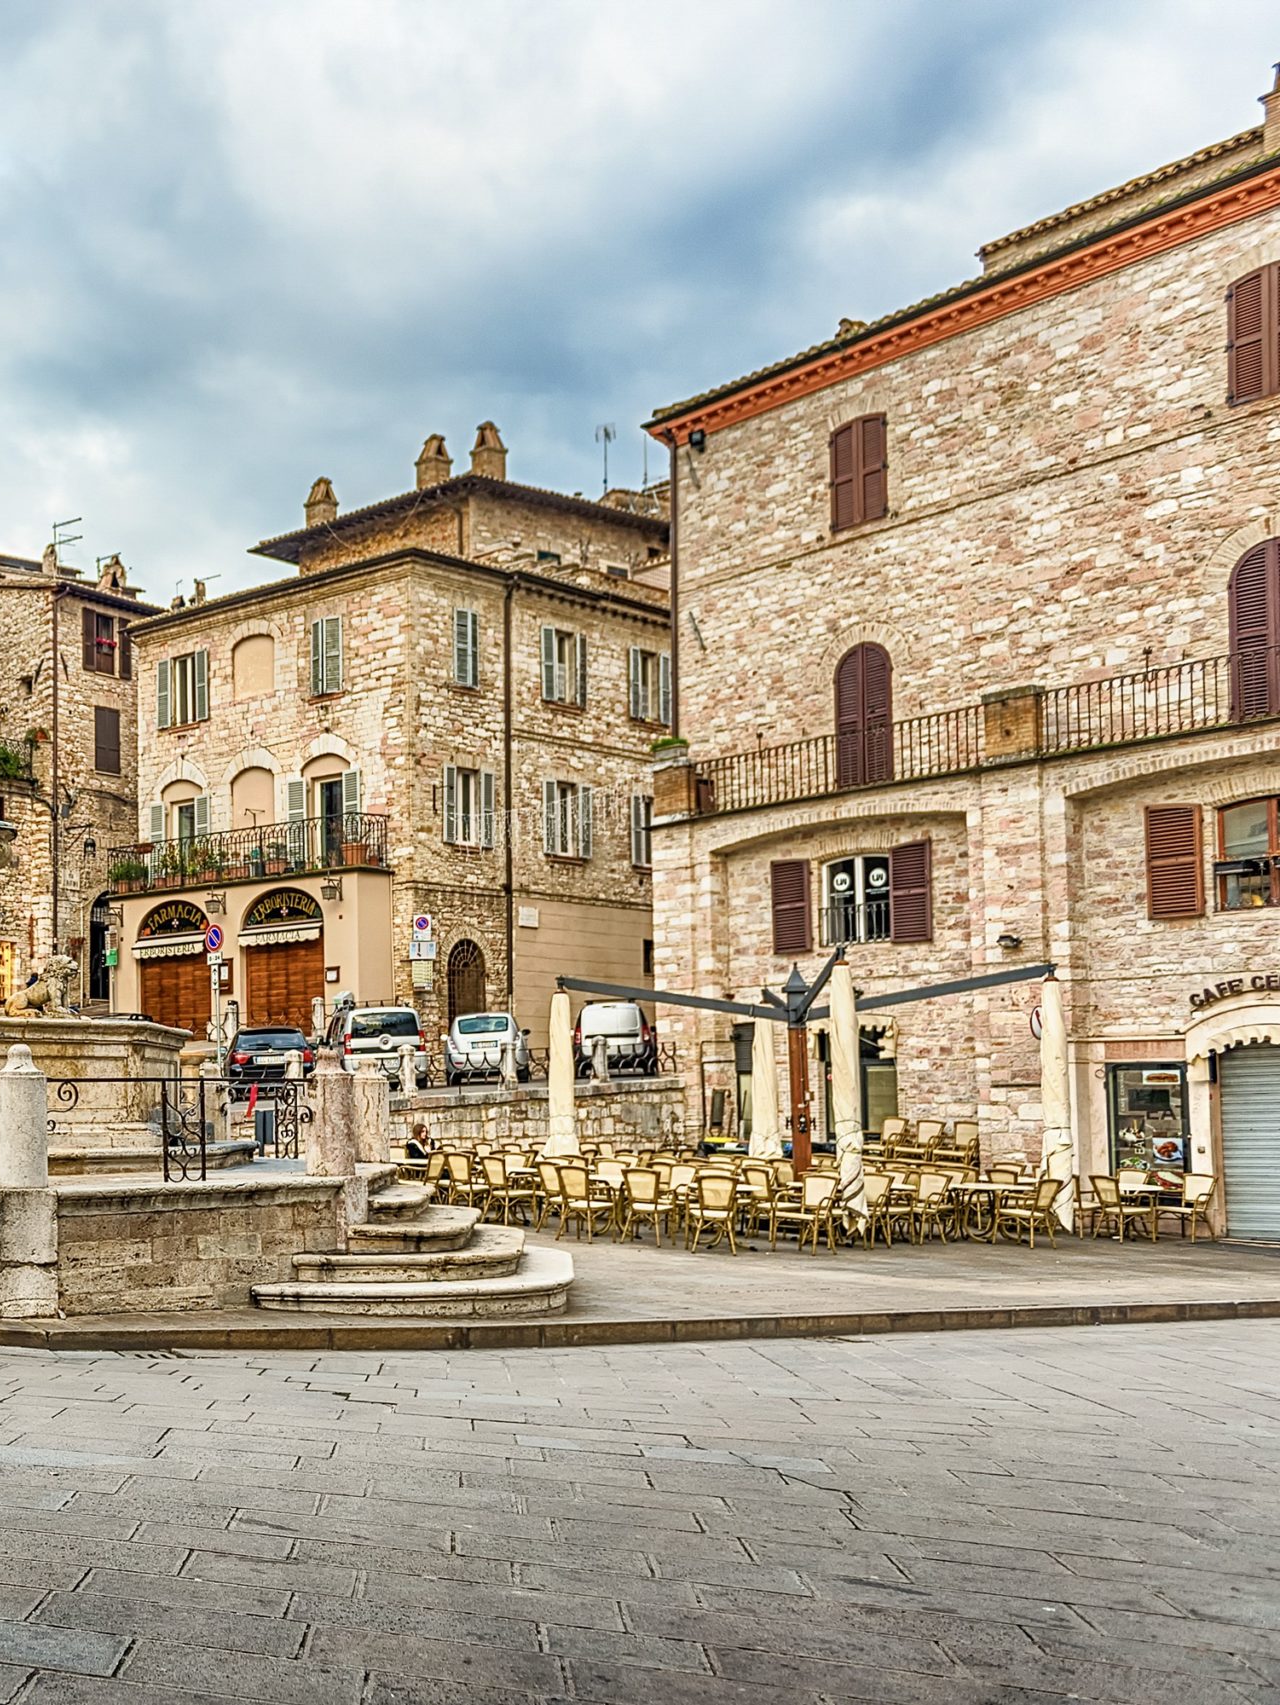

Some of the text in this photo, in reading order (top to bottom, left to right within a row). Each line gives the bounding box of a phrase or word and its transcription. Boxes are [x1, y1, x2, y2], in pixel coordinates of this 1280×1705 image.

[147, 904, 202, 931] FARMACIA
[253, 892, 316, 921] ERBORISTERIA
[1250, 975, 1280, 992] CE
